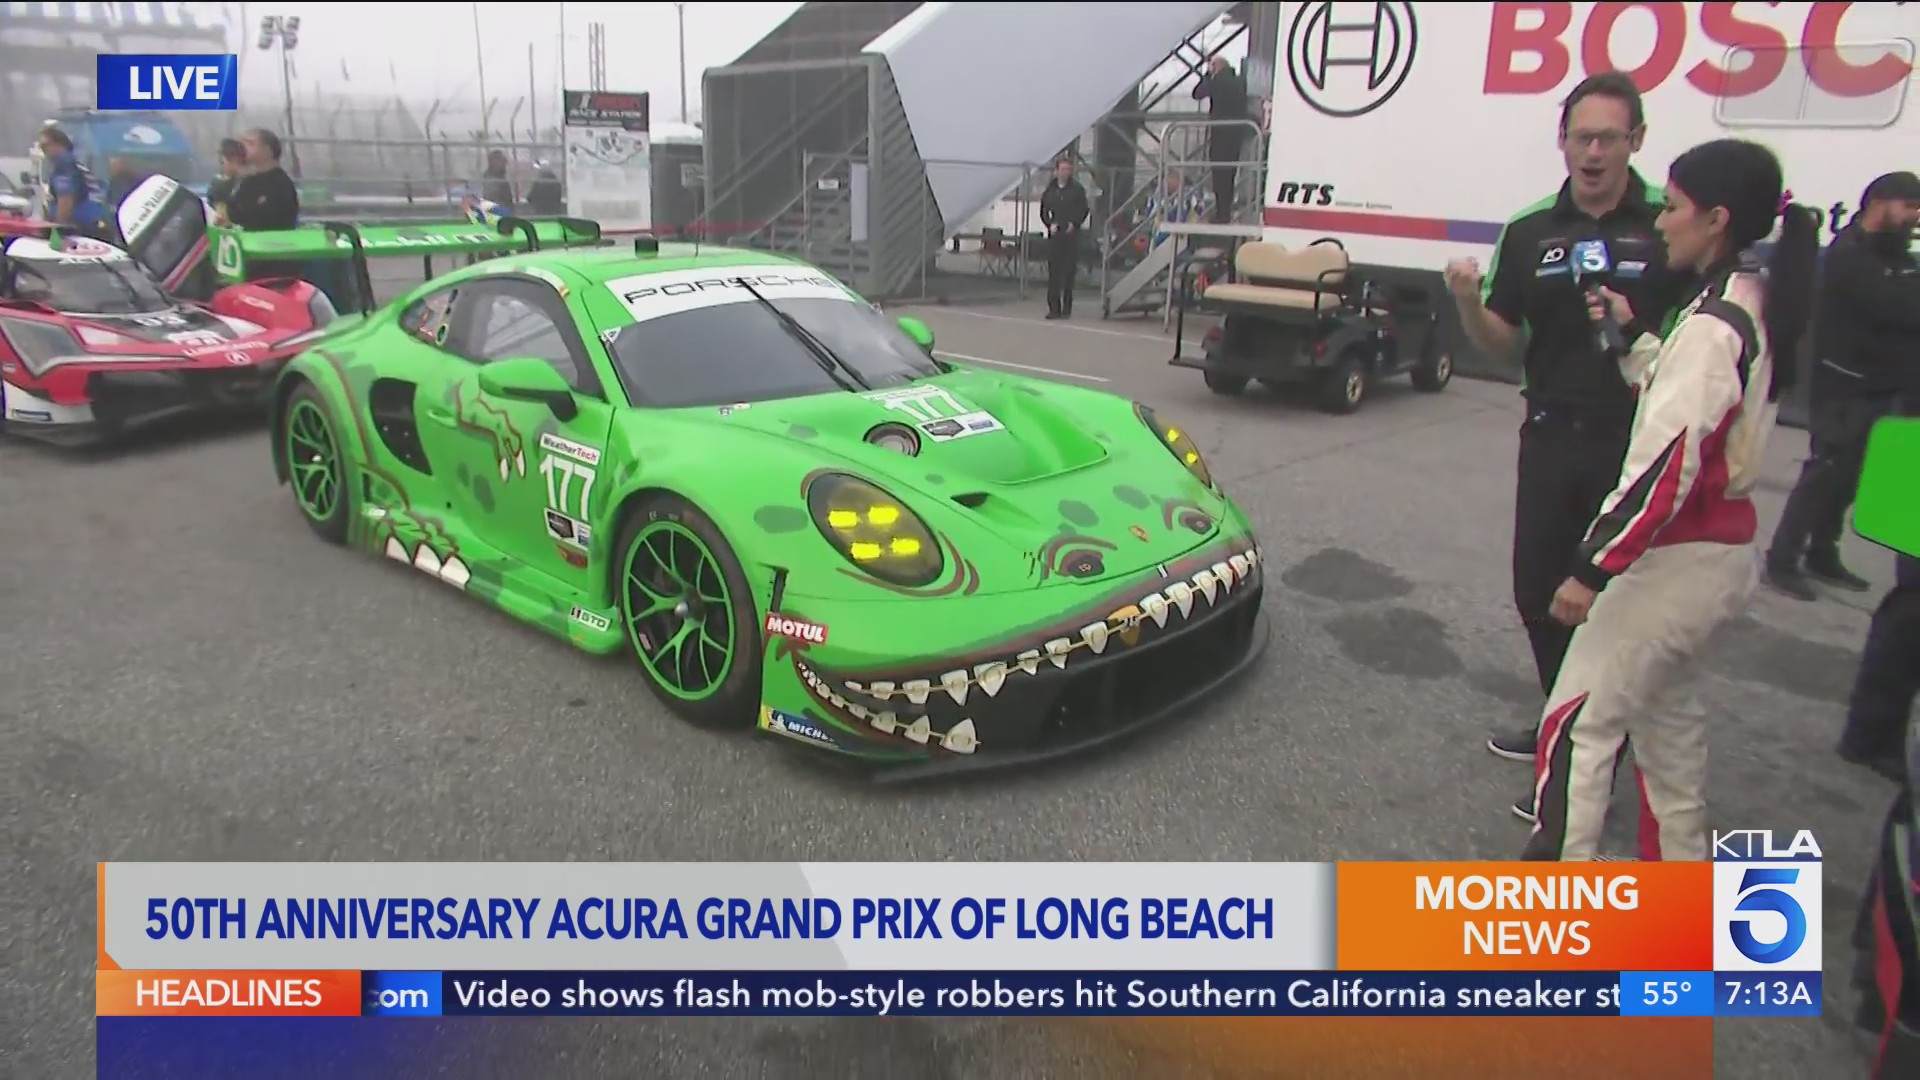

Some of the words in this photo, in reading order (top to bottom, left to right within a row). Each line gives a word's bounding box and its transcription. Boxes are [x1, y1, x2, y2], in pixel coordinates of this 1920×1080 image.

[1483, 2, 1914, 98] BOSC
[1277, 182, 1335, 206] RTS
[1582, 248, 1606, 271] 5
[624, 275, 837, 304] PORSCHE
[883, 390, 970, 422] 177
[543, 435, 597, 462] WeatherTech
[540, 454, 596, 521] 177
[767, 617, 825, 642] MOTUL
